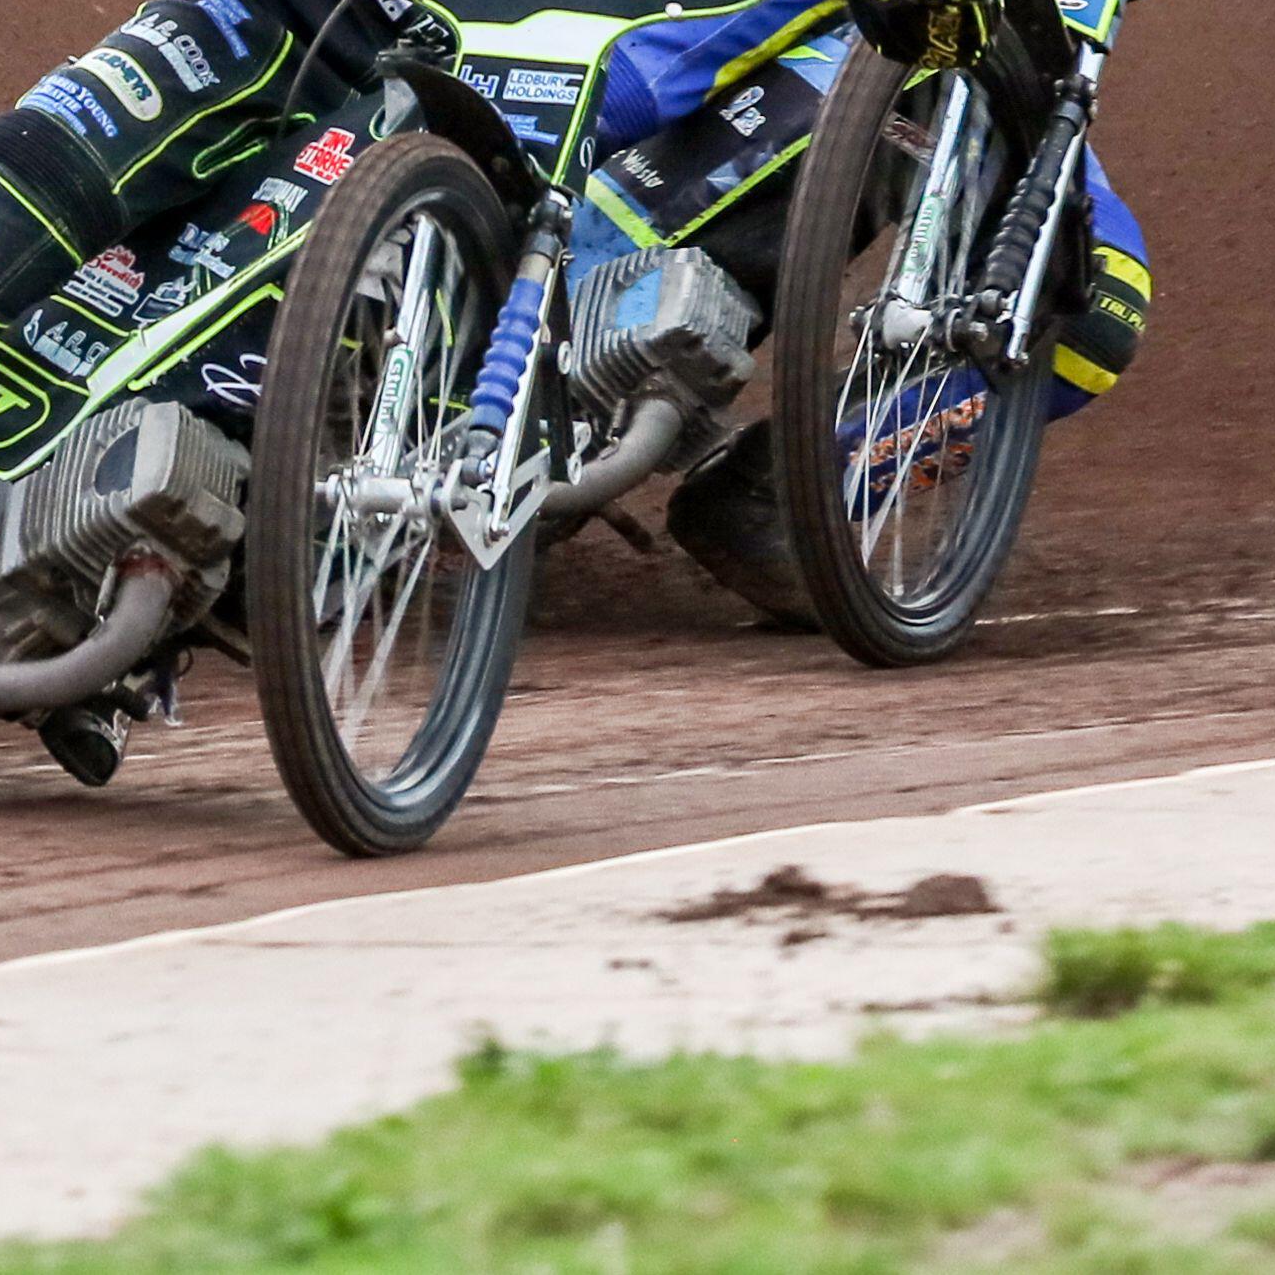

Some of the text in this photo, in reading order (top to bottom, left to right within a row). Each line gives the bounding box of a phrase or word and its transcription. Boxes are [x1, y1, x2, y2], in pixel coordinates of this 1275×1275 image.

[510, 71, 567, 88] LEDBURY
[506, 84, 578, 102] HOLDINGS
[77, 88, 120, 138] YOUNG
